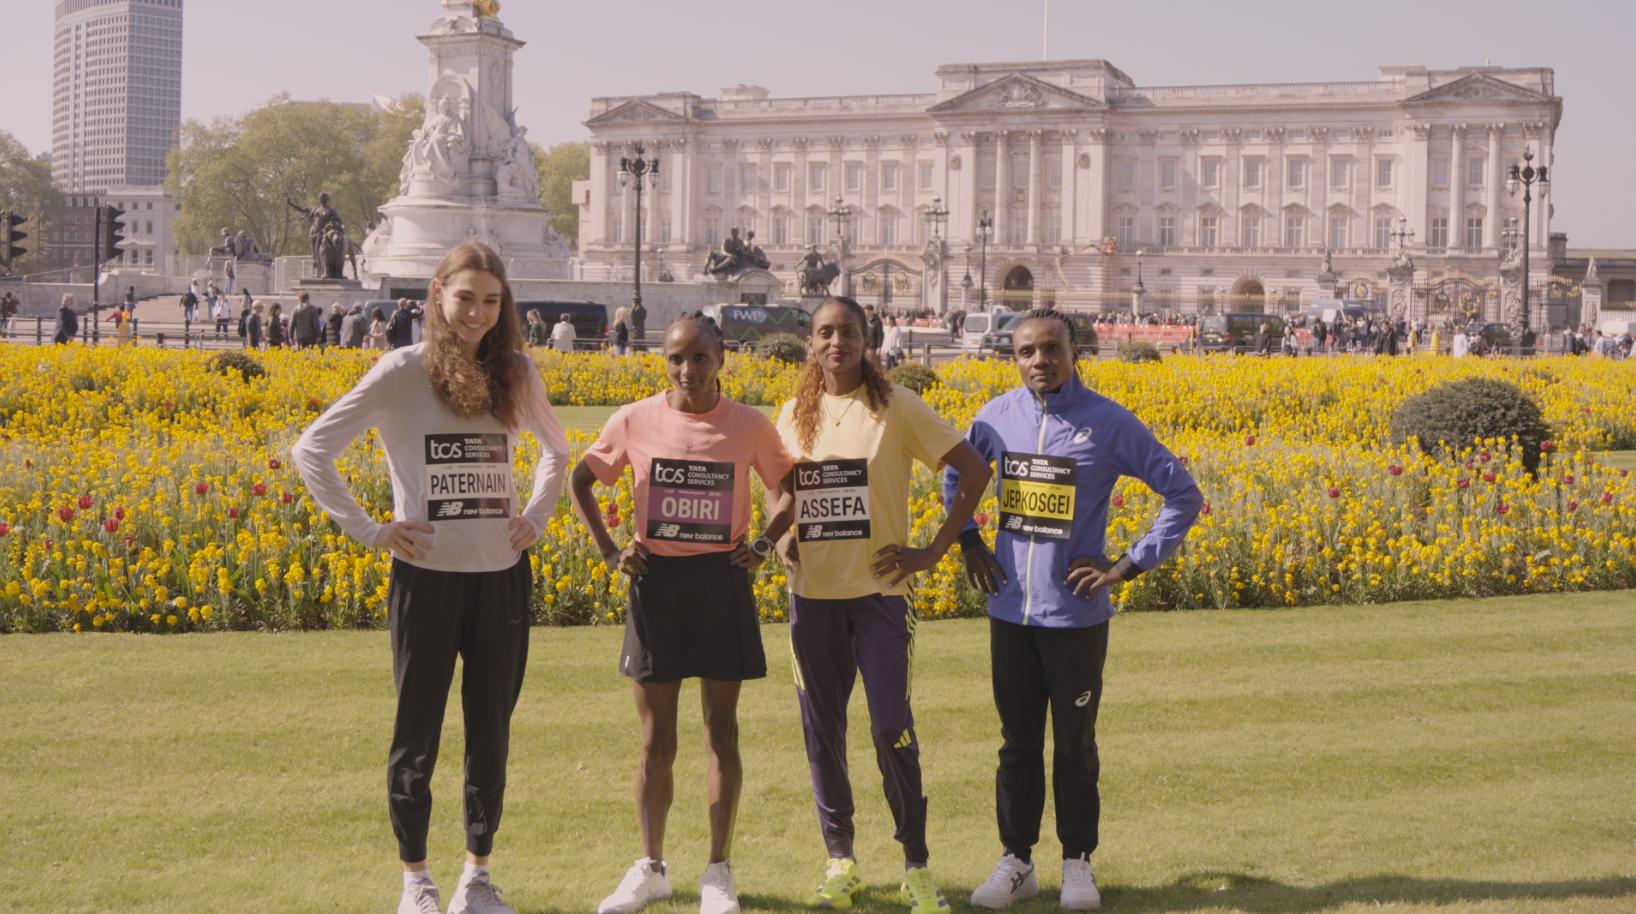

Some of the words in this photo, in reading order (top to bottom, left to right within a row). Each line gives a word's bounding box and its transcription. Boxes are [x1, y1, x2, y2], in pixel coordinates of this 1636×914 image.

[431, 440, 462, 459] tcs
[656, 463, 685, 484] tcs
[688, 472, 730, 480] CONSULTANCY
[1005, 456, 1029, 476] tcs
[1030, 466, 1071, 475] CONSULTANCY
[431, 474, 506, 494] PATERNAIN
[799, 468, 820, 485] tcs
[662, 497, 720, 520] OBIRI
[800, 496, 866, 518] ASSEFA
[1003, 489, 1070, 514] JEPKOSGEI
[1034, 526, 1063, 535] balance
